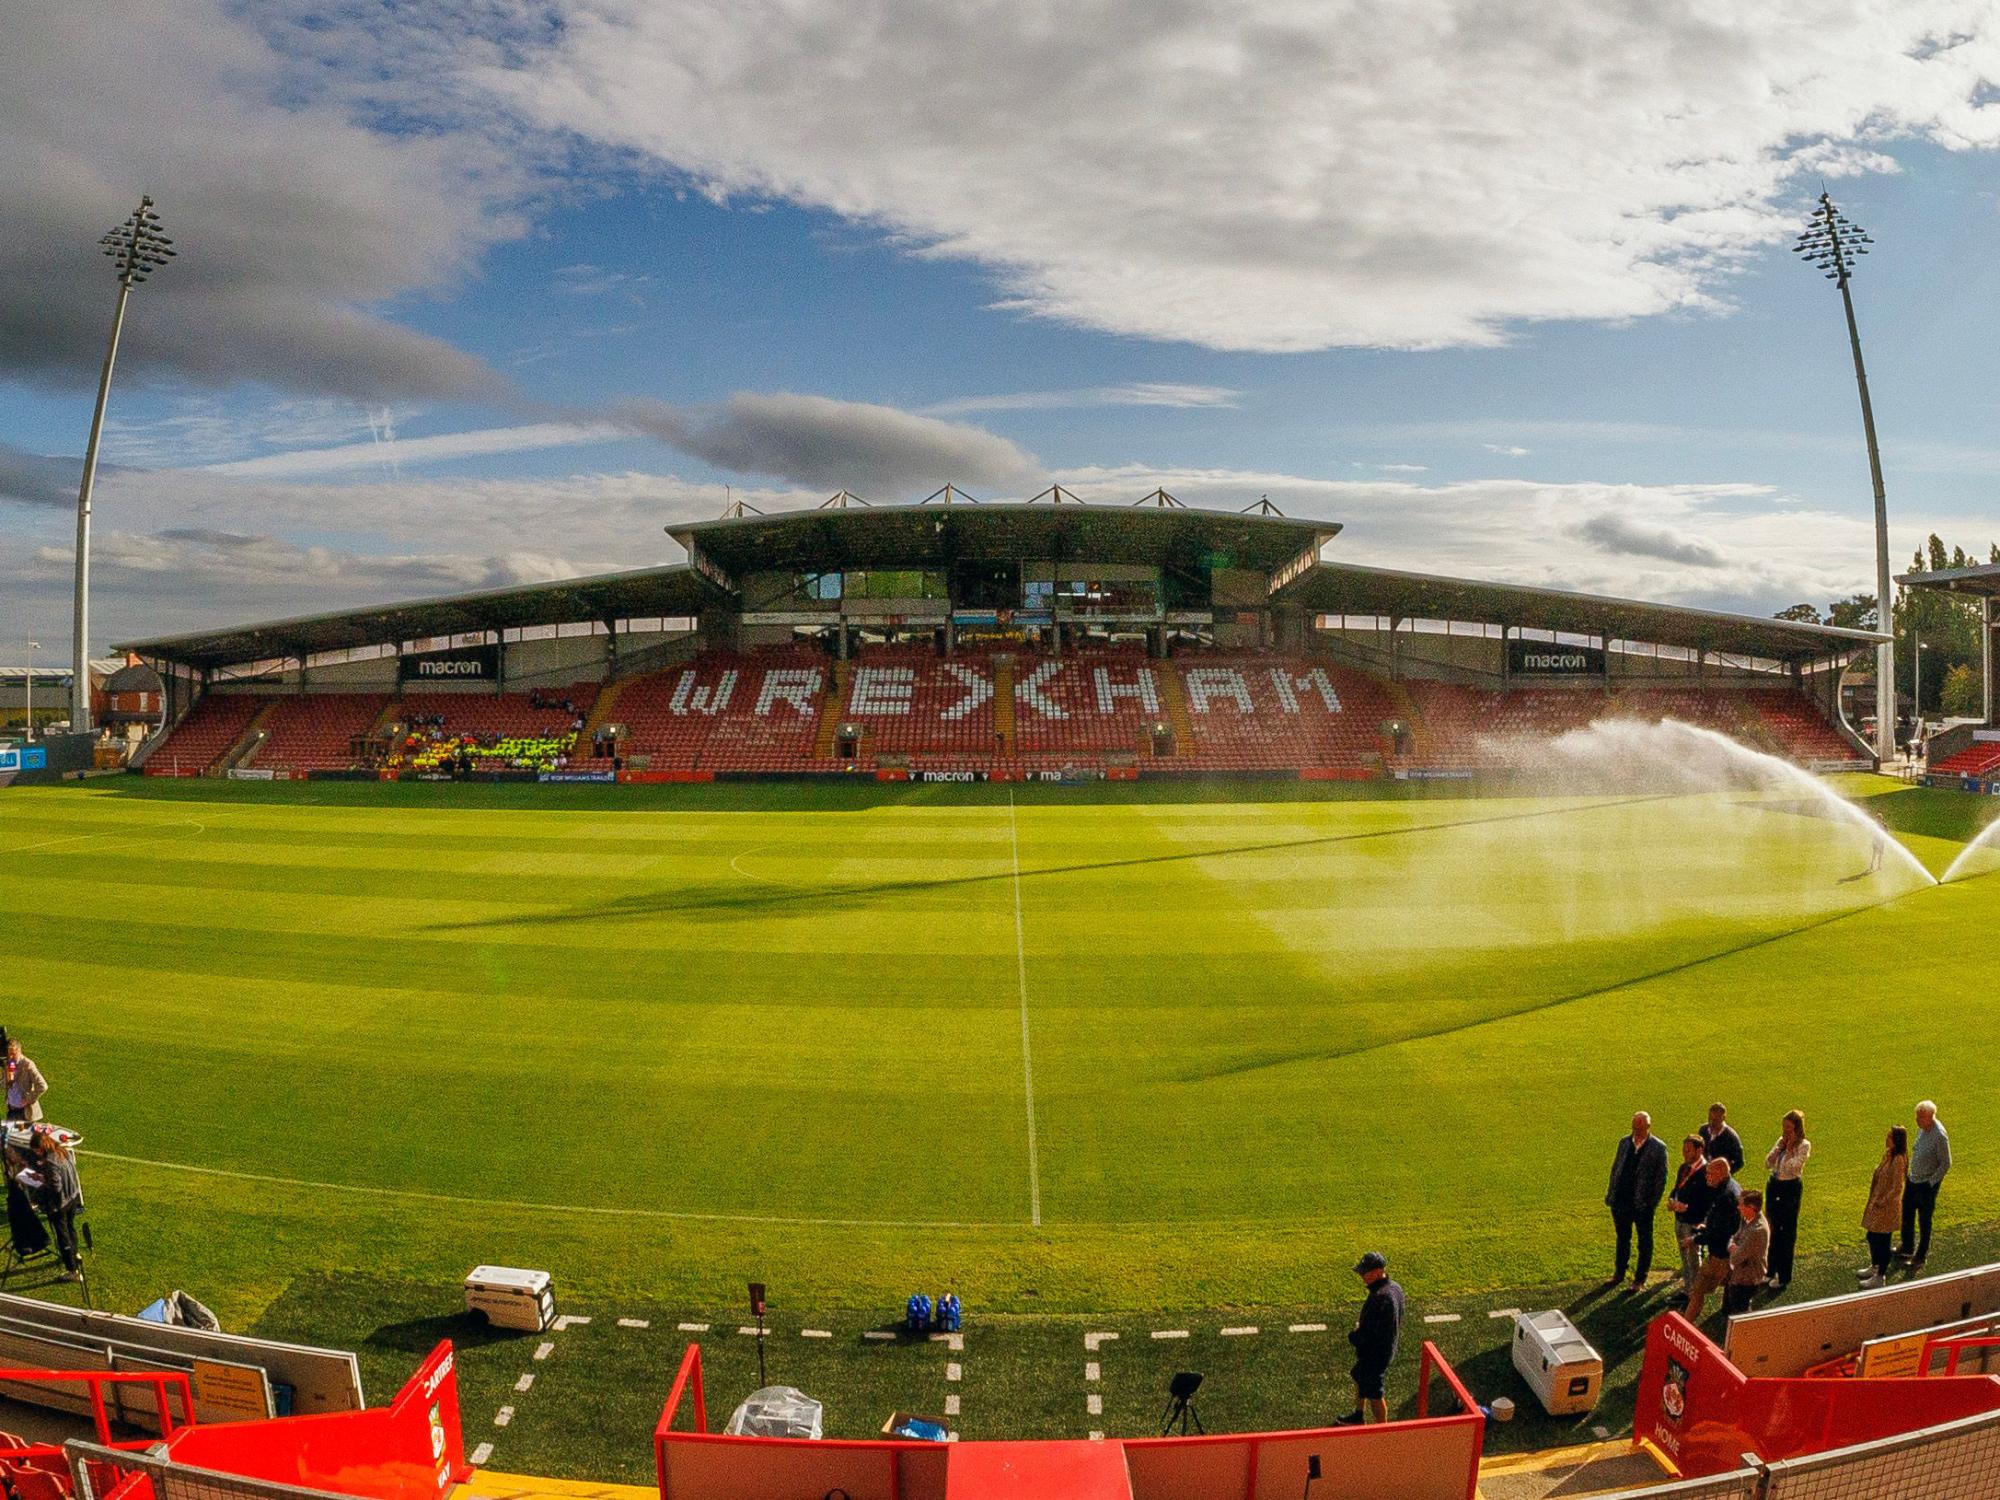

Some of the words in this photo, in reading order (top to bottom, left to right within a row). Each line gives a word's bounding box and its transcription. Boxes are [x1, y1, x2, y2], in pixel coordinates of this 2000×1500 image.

[419, 661, 481, 674] macron
[1524, 654, 1587, 668] macron
[923, 771, 975, 782] macron
[1663, 1323, 1700, 1362] CARTREF
[1654, 1421, 1681, 1457] HOME
